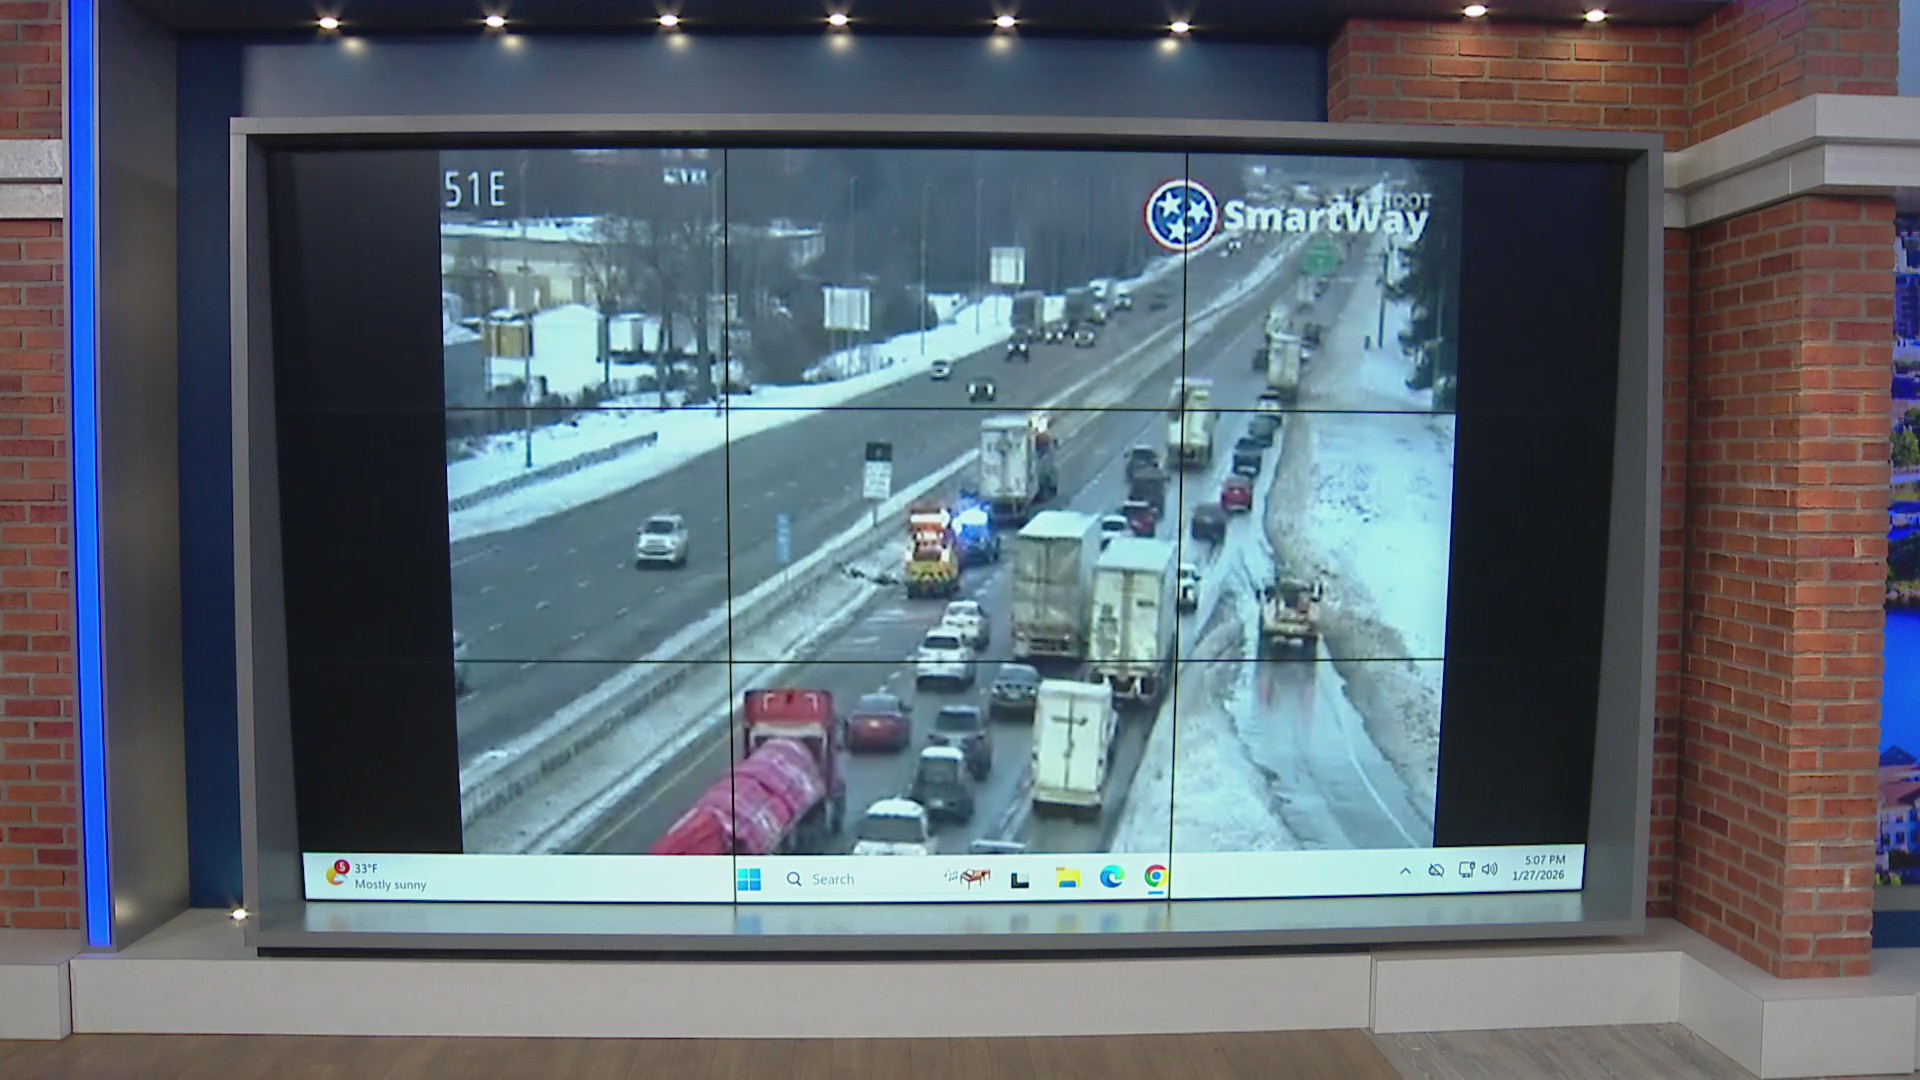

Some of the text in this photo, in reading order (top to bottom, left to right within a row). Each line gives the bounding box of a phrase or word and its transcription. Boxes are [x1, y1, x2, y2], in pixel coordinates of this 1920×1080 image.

[1223, 199, 1430, 242] SmartWay
[1525, 854, 1566, 866] 5:07 PM
[354, 863, 378, 874] 33°F
[812, 873, 855, 886] Search
[1512, 870, 1565, 881] 1/27/2026
[355, 879, 427, 892] Mostly sunny
